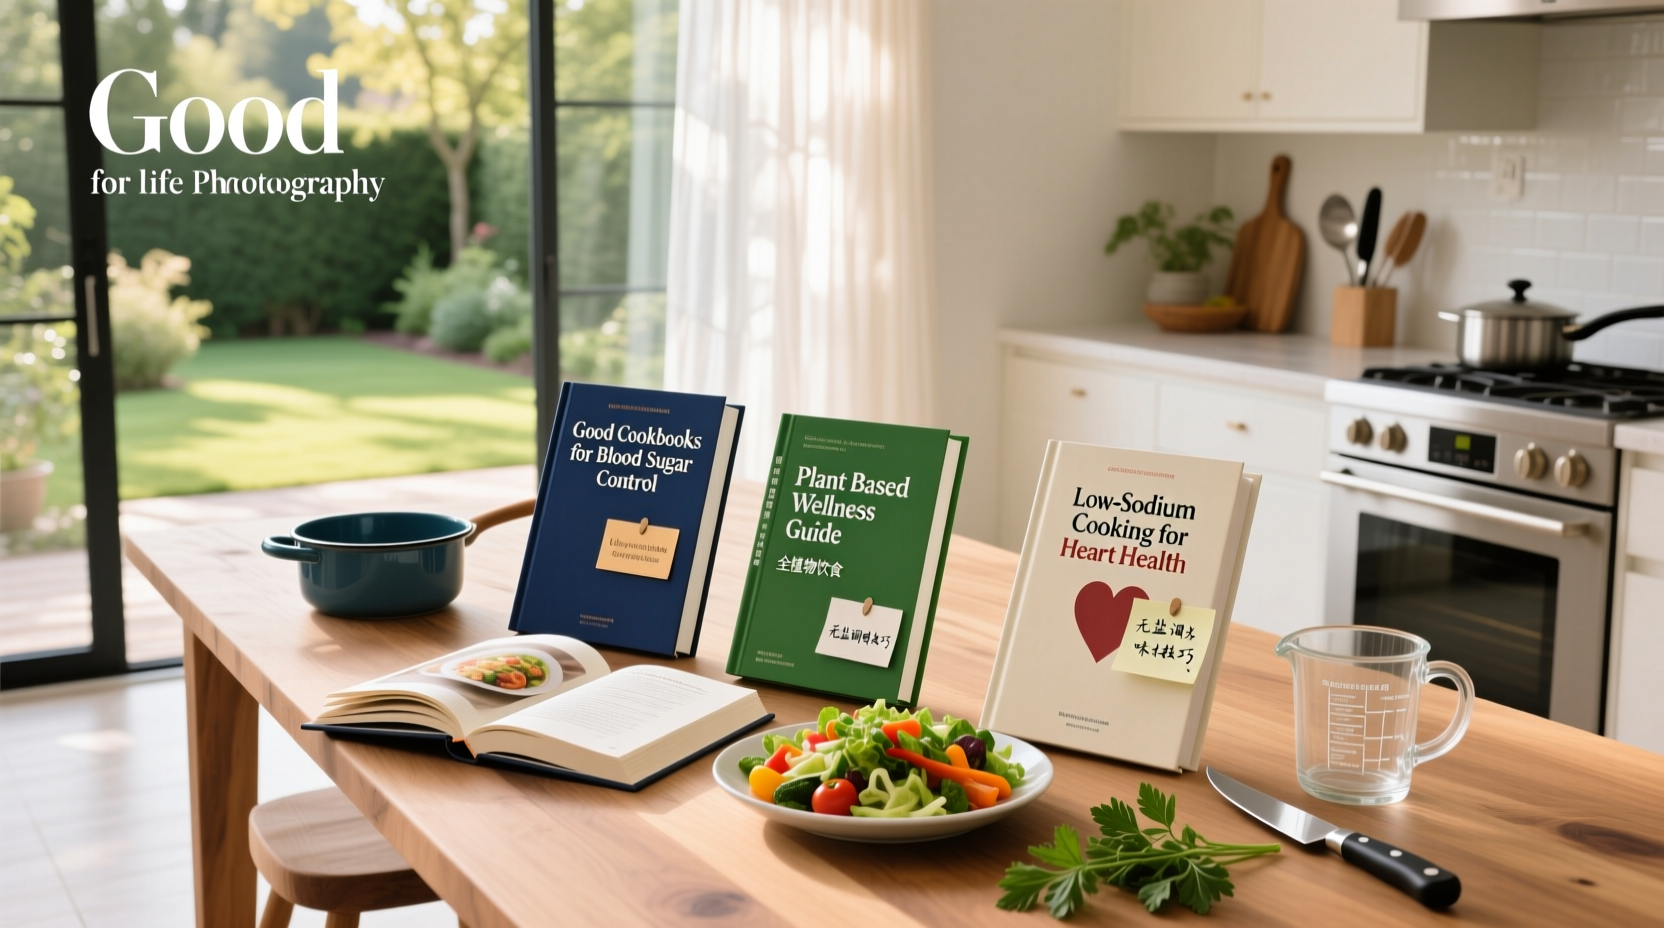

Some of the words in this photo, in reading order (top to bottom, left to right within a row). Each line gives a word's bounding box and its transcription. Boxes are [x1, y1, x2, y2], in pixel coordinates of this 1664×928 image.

[572, 420, 615, 441] Good
[617, 424, 702, 450] Cookbooks
[570, 442, 593, 462] for
[596, 446, 643, 468] Blood
[645, 451, 693, 475] Sugar
[596, 469, 658, 493] Control
[794, 465, 848, 492] Plant
[850, 472, 911, 498] Based
[792, 492, 876, 522] Wellness
[1072, 486, 1196, 521] Low-Sodium
[785, 518, 842, 545] Guide
[1072, 512, 1155, 547] Cooking
[1158, 523, 1189, 546] for
[1059, 537, 1116, 565] Heart
[1119, 545, 1187, 574] Health
